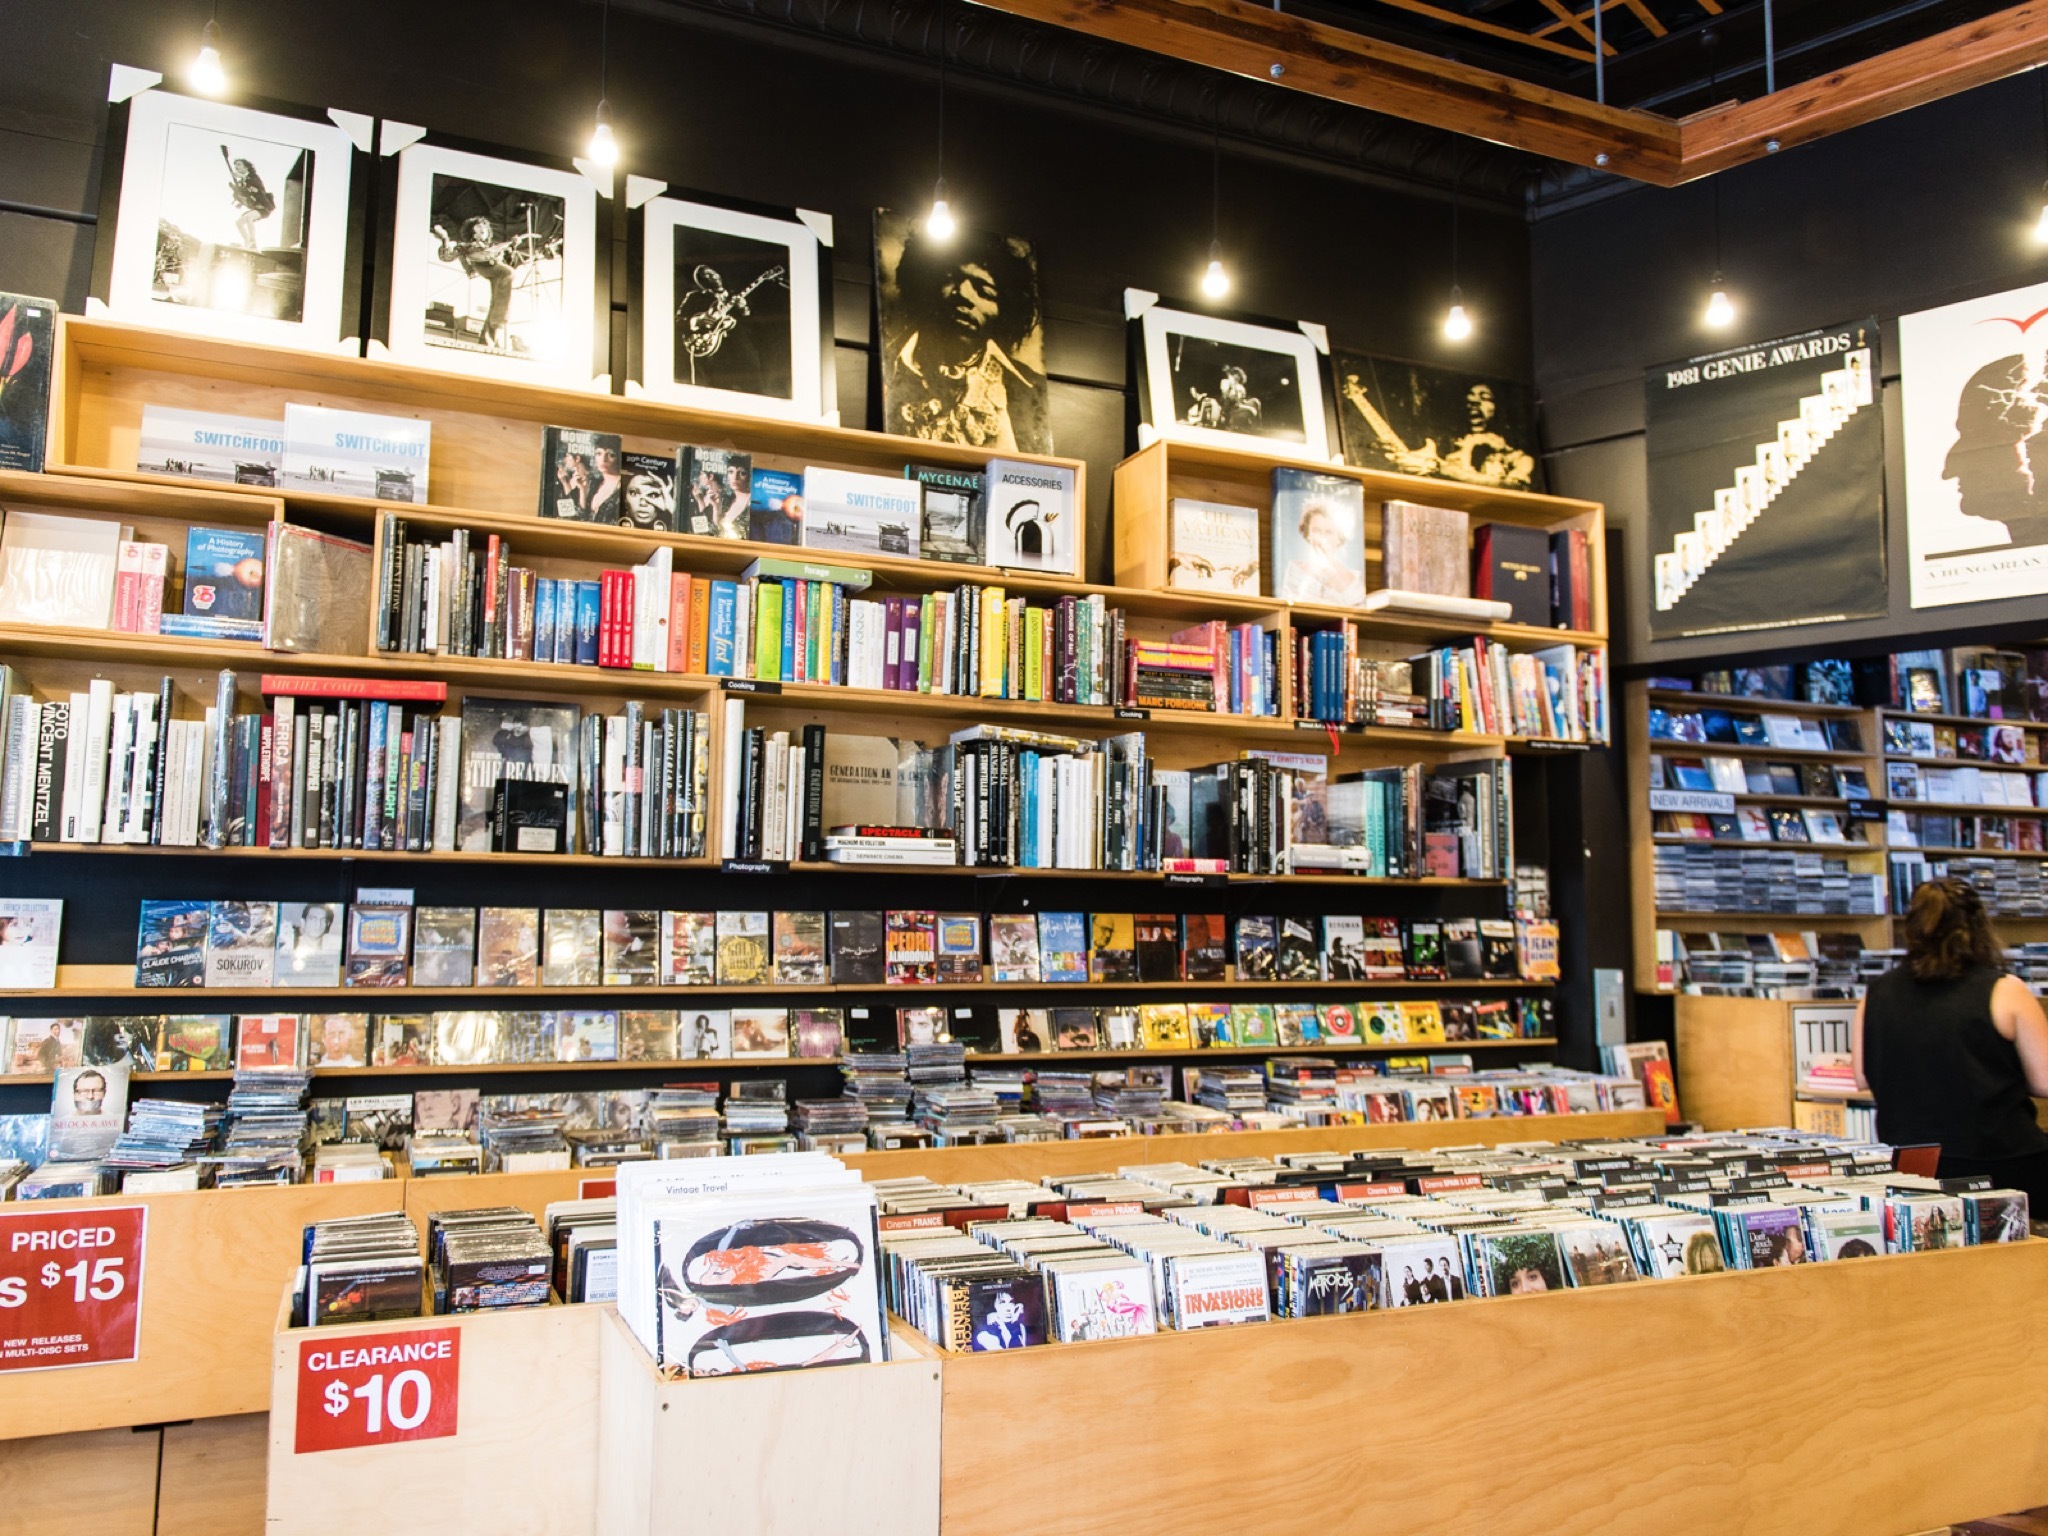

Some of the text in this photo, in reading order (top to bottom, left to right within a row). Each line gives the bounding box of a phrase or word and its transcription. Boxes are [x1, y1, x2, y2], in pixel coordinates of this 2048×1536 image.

[1666, 366, 1701, 389] 1981
[1702, 351, 1766, 381] GENIE
[1768, 332, 1852, 368] AWARDS
[194, 430, 284, 453] SWITCHFOOT
[335, 432, 426, 458] SWITCHFOOT
[560, 431, 591, 445] MOVIE
[640, 456, 668, 468] Century
[695, 448, 724, 462] MOVIE
[762, 482, 798, 494] Photography
[1002, 474, 1063, 491] ACCESSORIES
[846, 493, 916, 513] SWITCHFOOT
[1409, 520, 1455, 539] WOOD
[206, 545, 255, 558] Photography
[216, 539, 244, 549] History
[804, 566, 830, 578] forage
[784, 623, 792, 648] GREECE
[796, 632, 804, 672] FRANCE
[270, 680, 320, 692] MICHEL
[728, 681, 755, 692] Cooking
[1138, 696, 1163, 709] MARC
[55, 702, 70, 740] FOTO
[1120, 710, 1143, 719] Cooking
[274, 713, 289, 766] AFRICA
[260, 726, 272, 782] MAPPLETHORPE
[665, 723, 674, 790] HASSELBLAD
[35, 702, 57, 827] VINCENT MENTZEL
[829, 765, 879, 778] GENERATION
[471, 759, 569, 788] THE BEATLES
[385, 785, 396, 819] LIGHT
[809, 768, 821, 827] GENERATION AK
[1653, 794, 1732, 810] NEW ARRIVALS
[5, 805, 16, 824] BEST
[861, 827, 921, 838] SPECTACLE
[729, 863, 771, 873] Photography
[1170, 875, 1204, 884] Photography
[888, 931, 935, 950] PEDRO
[142, 956, 170, 969] CLAUDE
[216, 959, 265, 971] SOKUROV
[54, 1119, 118, 1129] SHOCK & AWE
[666, 1183, 728, 1195] Vintage Travel
[1256, 1188, 1316, 1201] Cinema WEST EUROPE
[1367, 1185, 1404, 1195] Cinema ITALY
[1091, 1204, 1141, 1216] Cinema FRANCE
[886, 1216, 942, 1229] Cinema FRANCE
[11, 1227, 116, 1252] PRICED
[41, 1257, 125, 1303] $15
[1186, 1294, 1264, 1314] INVASIONS
[953, 1289, 965, 1352] BEINEIX
[3, 1334, 82, 1348] NEW RELEASES
[5, 1344, 89, 1358] MULTI-DISC SETS
[308, 1340, 452, 1372] CLEARANCE
[323, 1369, 431, 1433] $10
